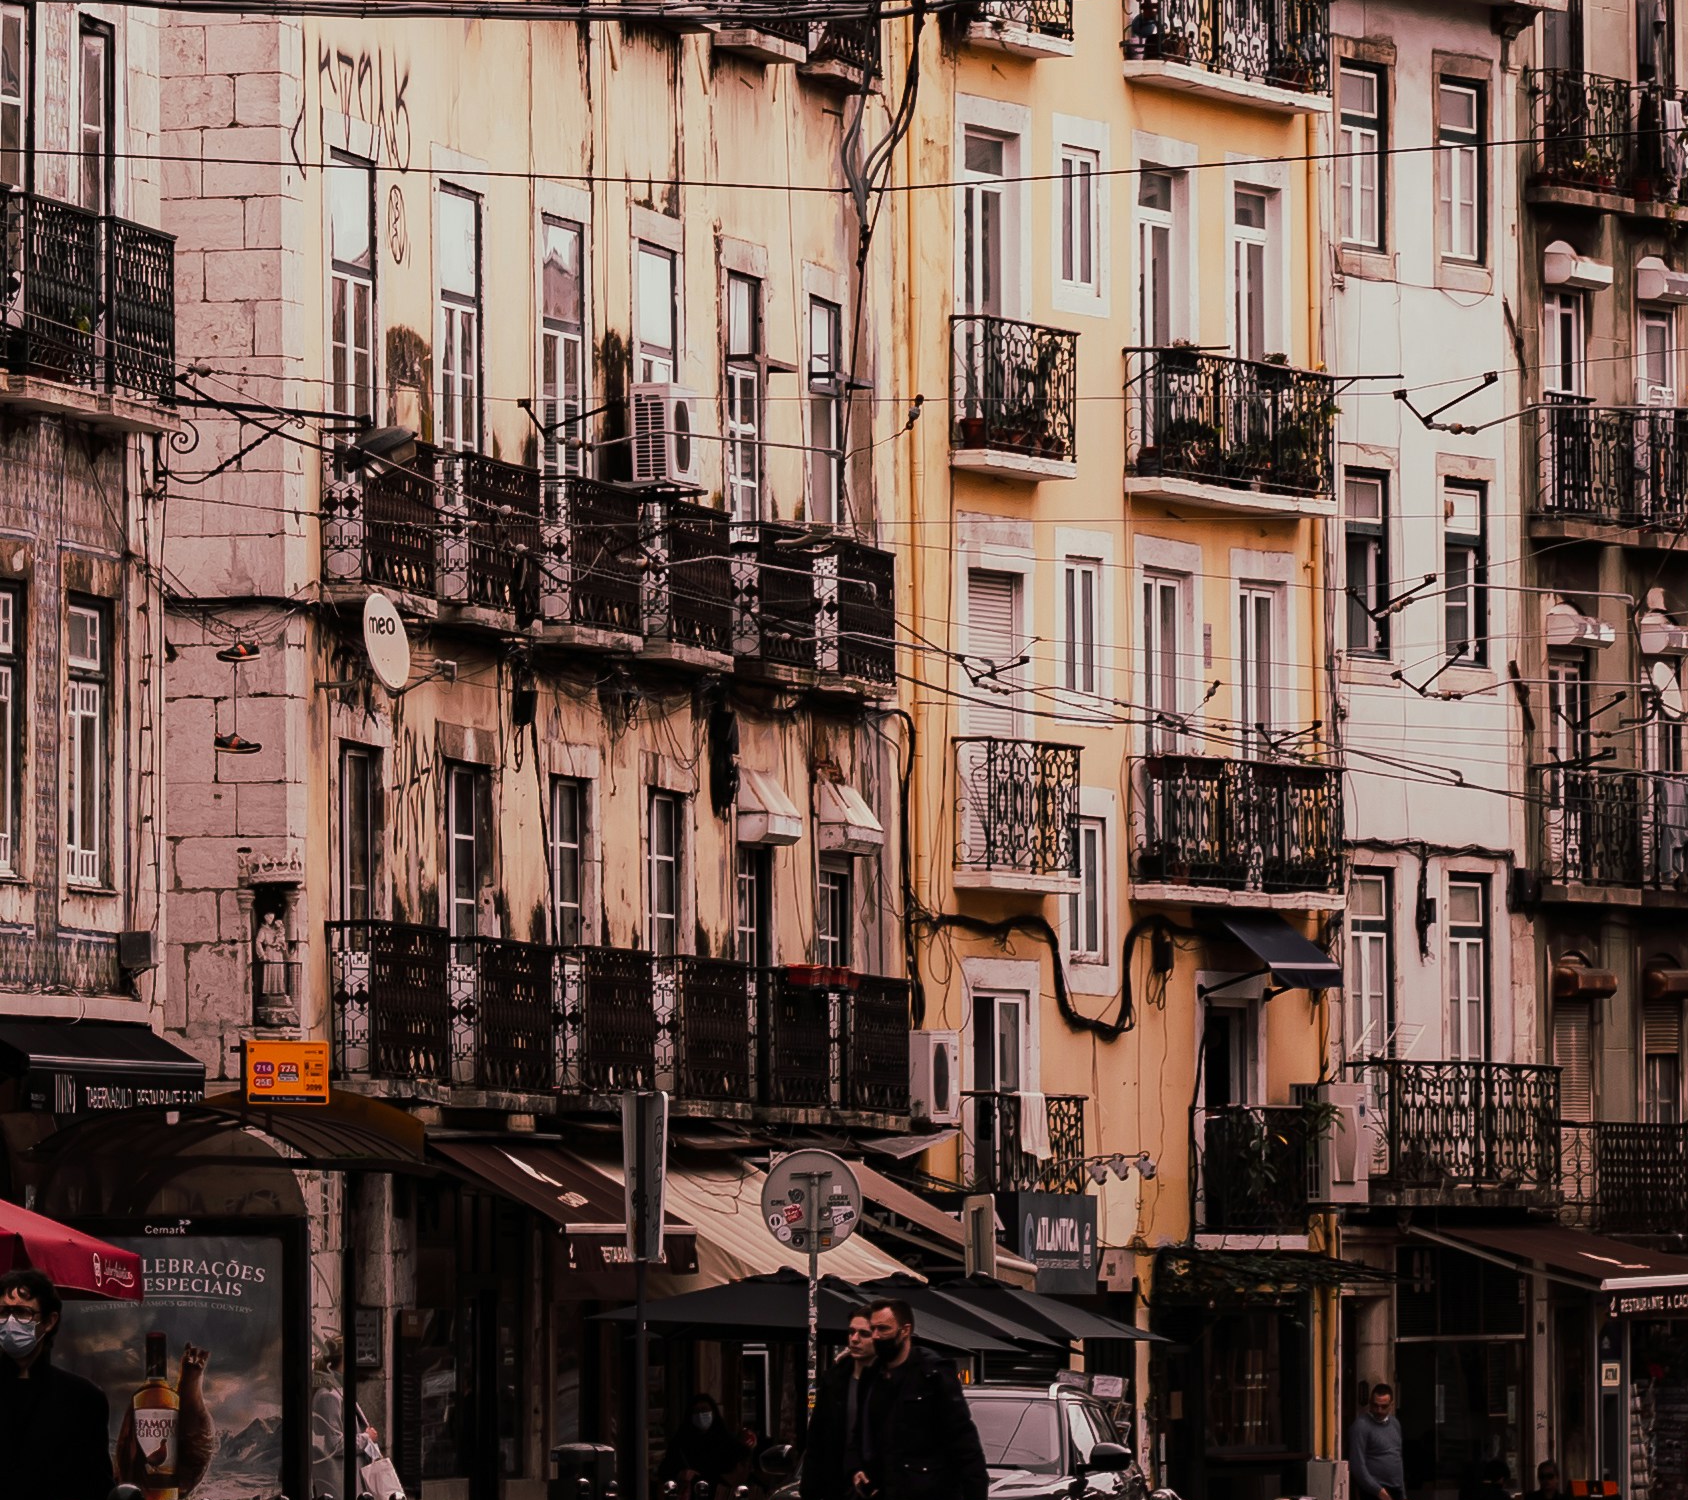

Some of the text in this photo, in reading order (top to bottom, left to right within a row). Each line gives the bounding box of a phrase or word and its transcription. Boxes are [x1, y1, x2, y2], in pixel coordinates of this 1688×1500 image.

[368, 615, 396, 636] meo
[256, 1064, 273, 1072] 714
[144, 1224, 187, 1235] Cemark
[142, 1257, 266, 1283] LEBRAÇÕES
[143, 1276, 243, 1297] ESPECIAIS
